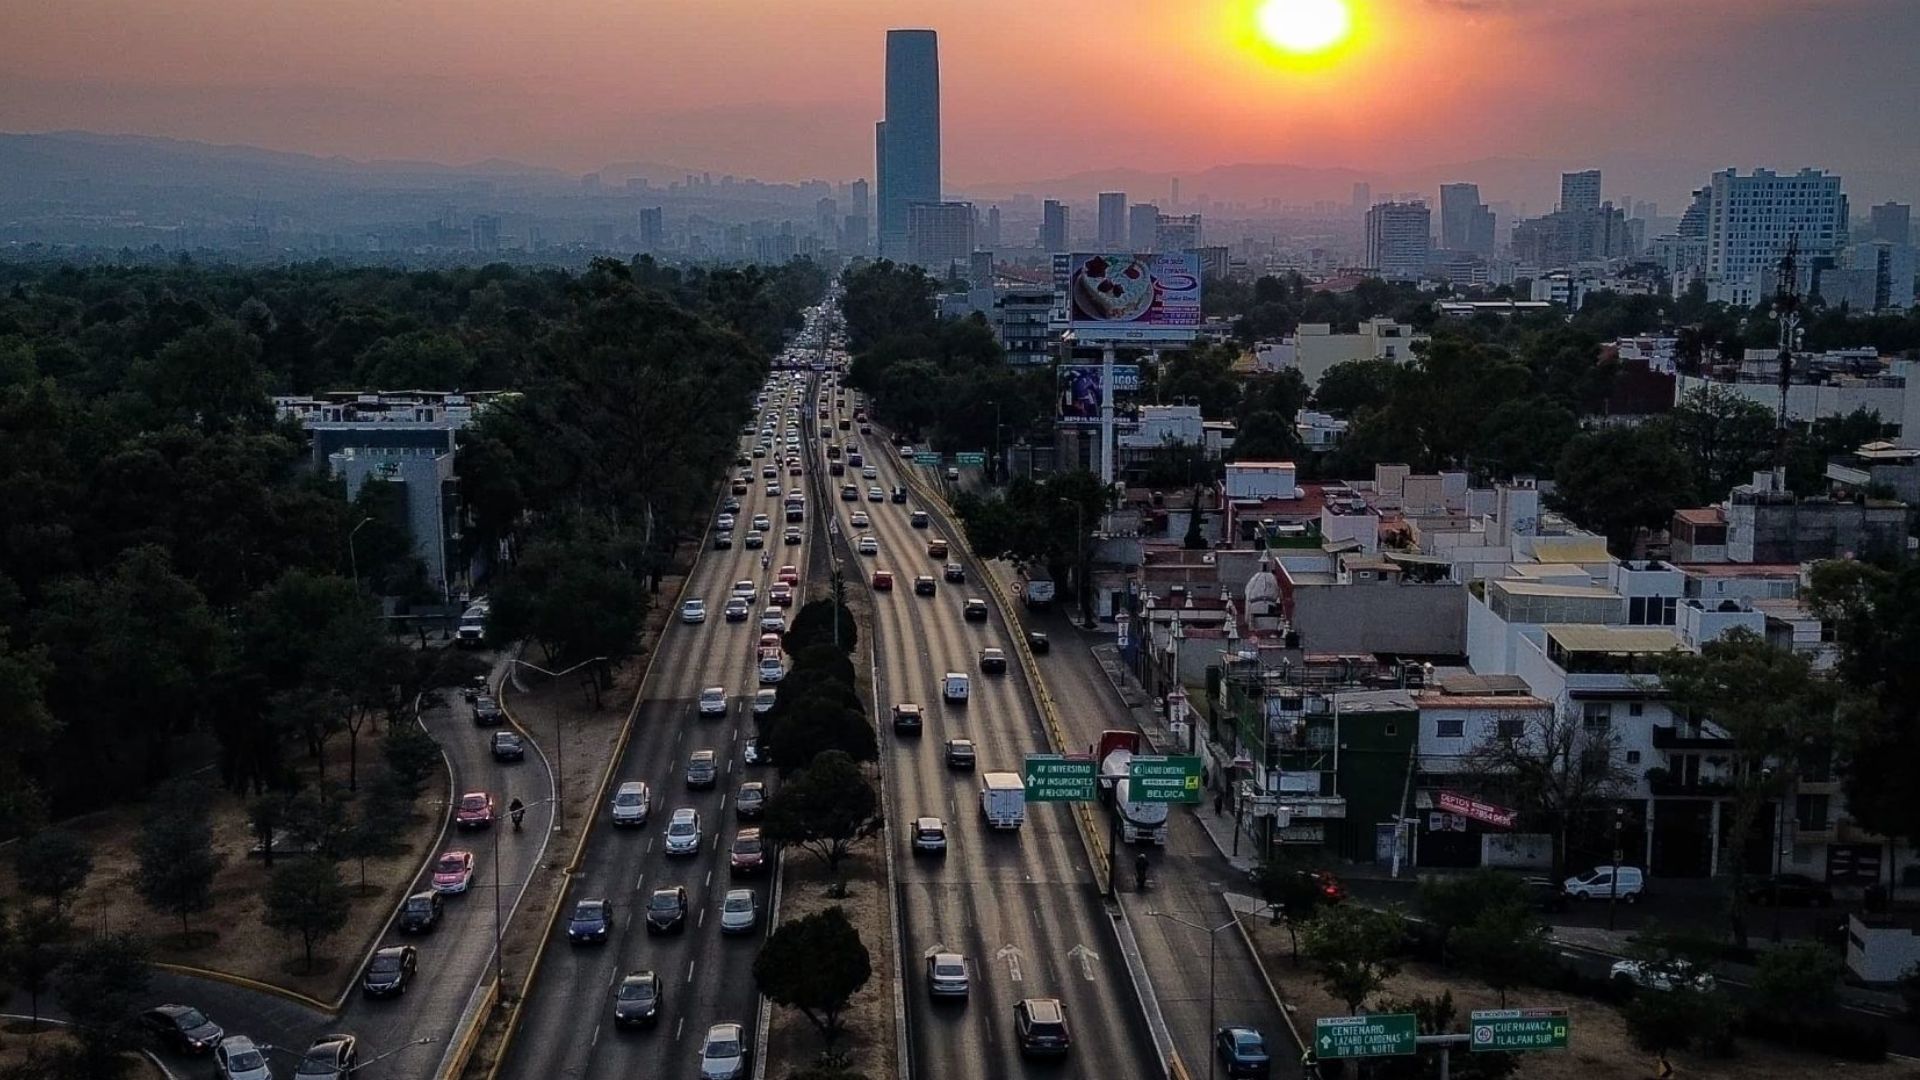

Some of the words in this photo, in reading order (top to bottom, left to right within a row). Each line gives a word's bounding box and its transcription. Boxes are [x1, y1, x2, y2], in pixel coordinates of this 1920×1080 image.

[1047, 765, 1091, 774] UNIVERSIDAD
[1047, 777, 1093, 786] INSURGENTES
[1146, 789, 1185, 798] BELGICA
[1331, 1024, 1385, 1036] CENTENARIO
[1494, 1021, 1552, 1033] CUERNAVACA
[1496, 1035, 1533, 1045] TLALPAN
[1535, 1034, 1552, 1044] SUR
[1372, 1043, 1396, 1054] NORTE
